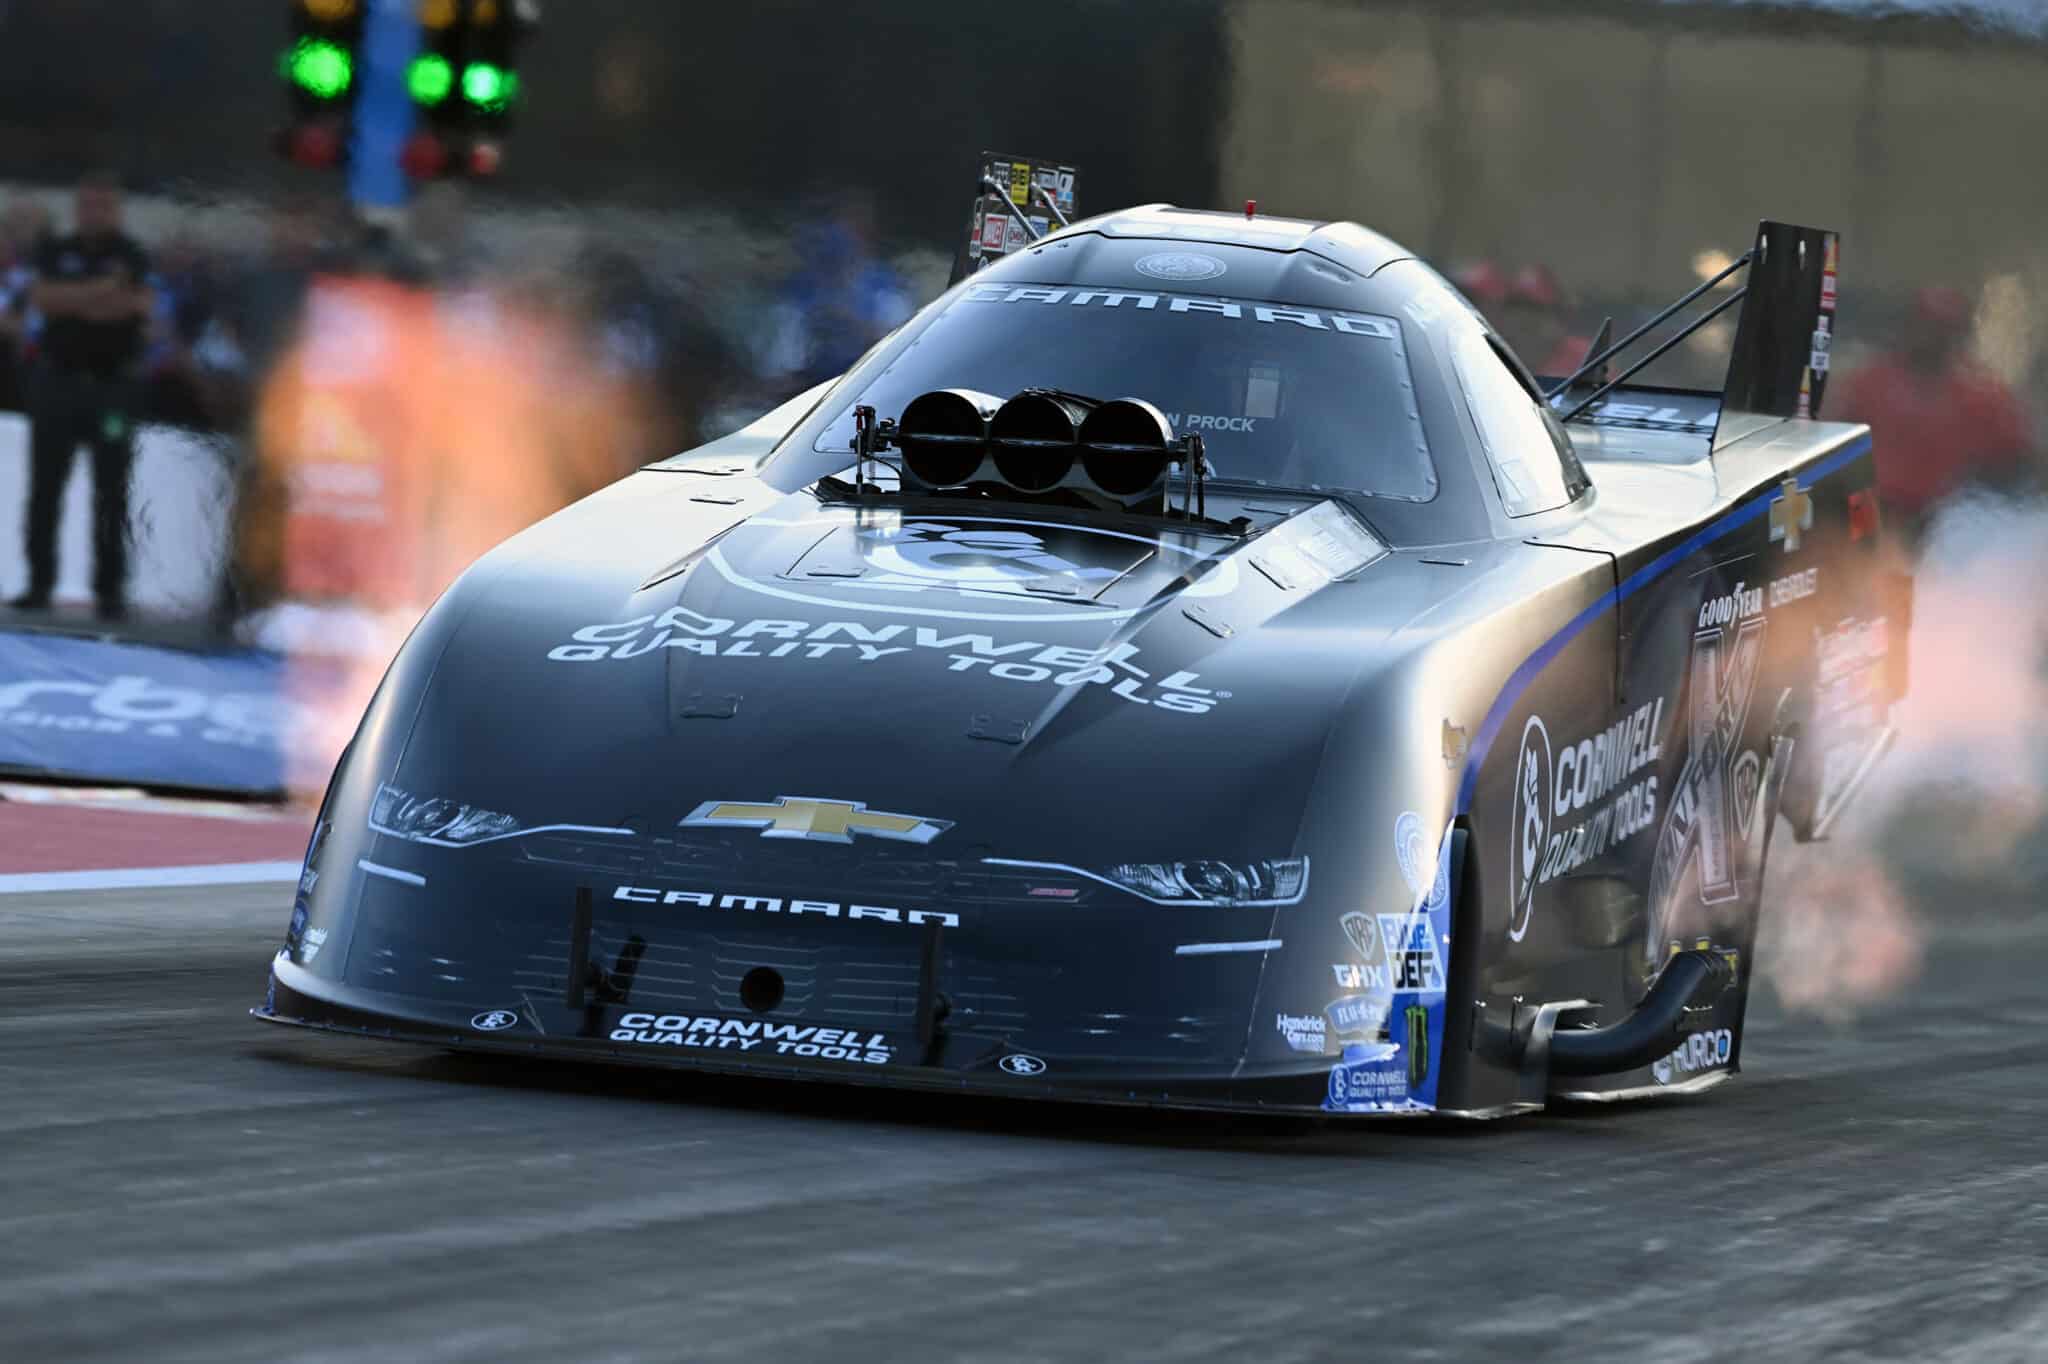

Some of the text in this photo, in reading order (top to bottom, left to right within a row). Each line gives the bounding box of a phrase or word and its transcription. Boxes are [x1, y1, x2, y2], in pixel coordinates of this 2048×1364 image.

[965, 284, 1396, 340] CAMARO
[1186, 414, 1256, 432] PROCK
[572, 606, 1213, 695] CORNWELL
[547, 629, 1217, 714] QUALITY TOOLS
[1555, 697, 1664, 817] CORNWELL
[613, 886, 960, 927] CAMARO
[619, 1013, 890, 1051] CORNWELL
[1277, 1013, 1326, 1036] Hendrick
[610, 1029, 892, 1064] QUALITY TOOLS
